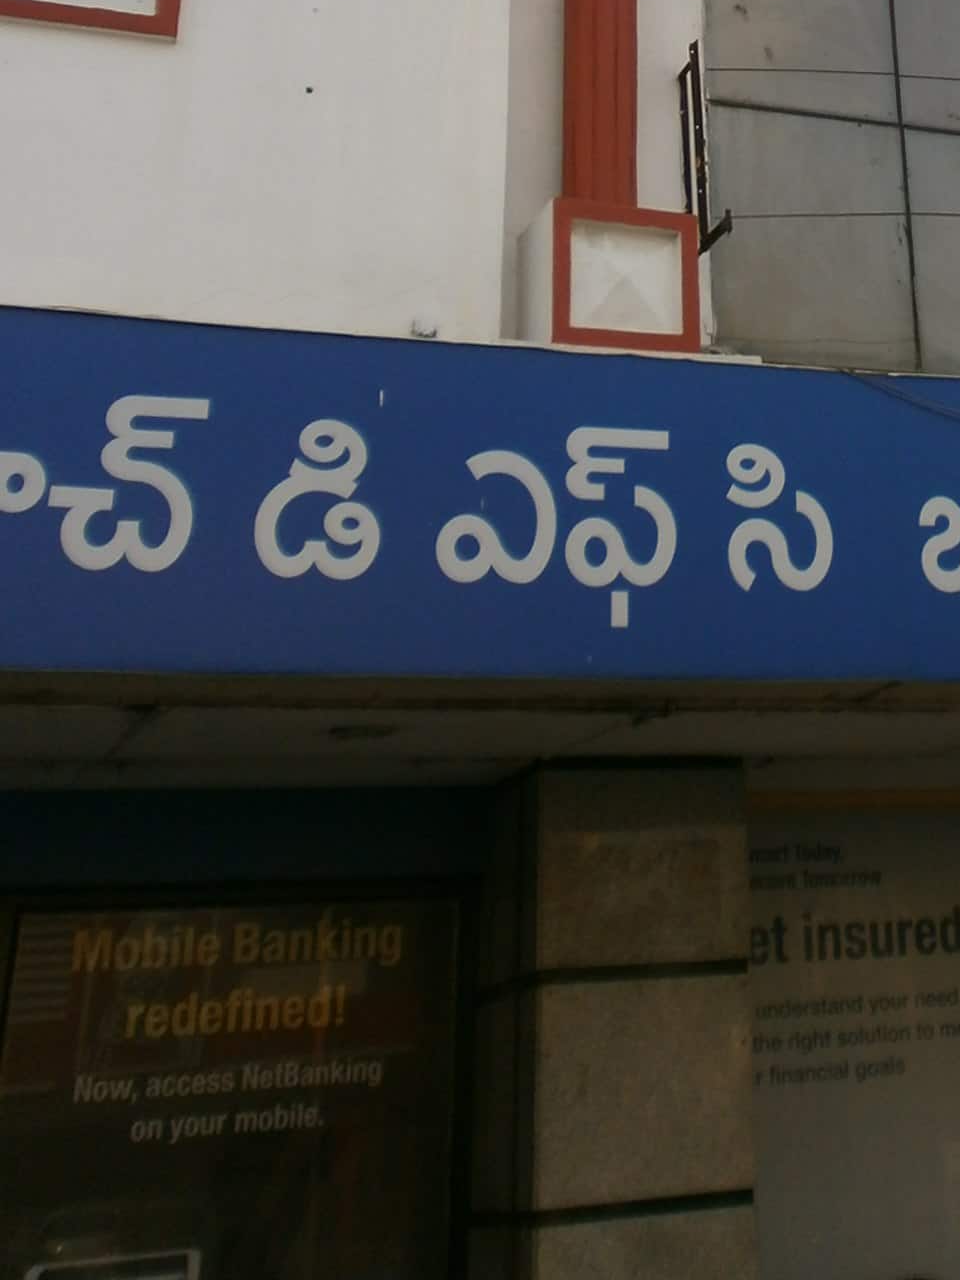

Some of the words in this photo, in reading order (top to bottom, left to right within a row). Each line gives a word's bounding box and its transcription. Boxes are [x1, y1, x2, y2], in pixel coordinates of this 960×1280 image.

[71, 925, 219, 972] Mobile
[233, 918, 403, 966] Banking
[124, 984, 347, 1039] redefined!
[755, 995, 864, 1019] understand
[868, 995, 909, 1016] your
[914, 987, 960, 1009] need
[752, 1030, 782, 1054] the
[787, 1028, 832, 1055] right
[837, 1023, 911, 1048] solution
[916, 1023, 935, 1041] to
[73, 1073, 139, 1104] Now,
[146, 1074, 235, 1098] access
[240, 1056, 384, 1090] NetBanking
[767, 1059, 849, 1085] financial
[855, 1056, 907, 1083] goals
[130, 1119, 161, 1142] on
[169, 1113, 227, 1144] your
[233, 1103, 326, 1134] mobile.
